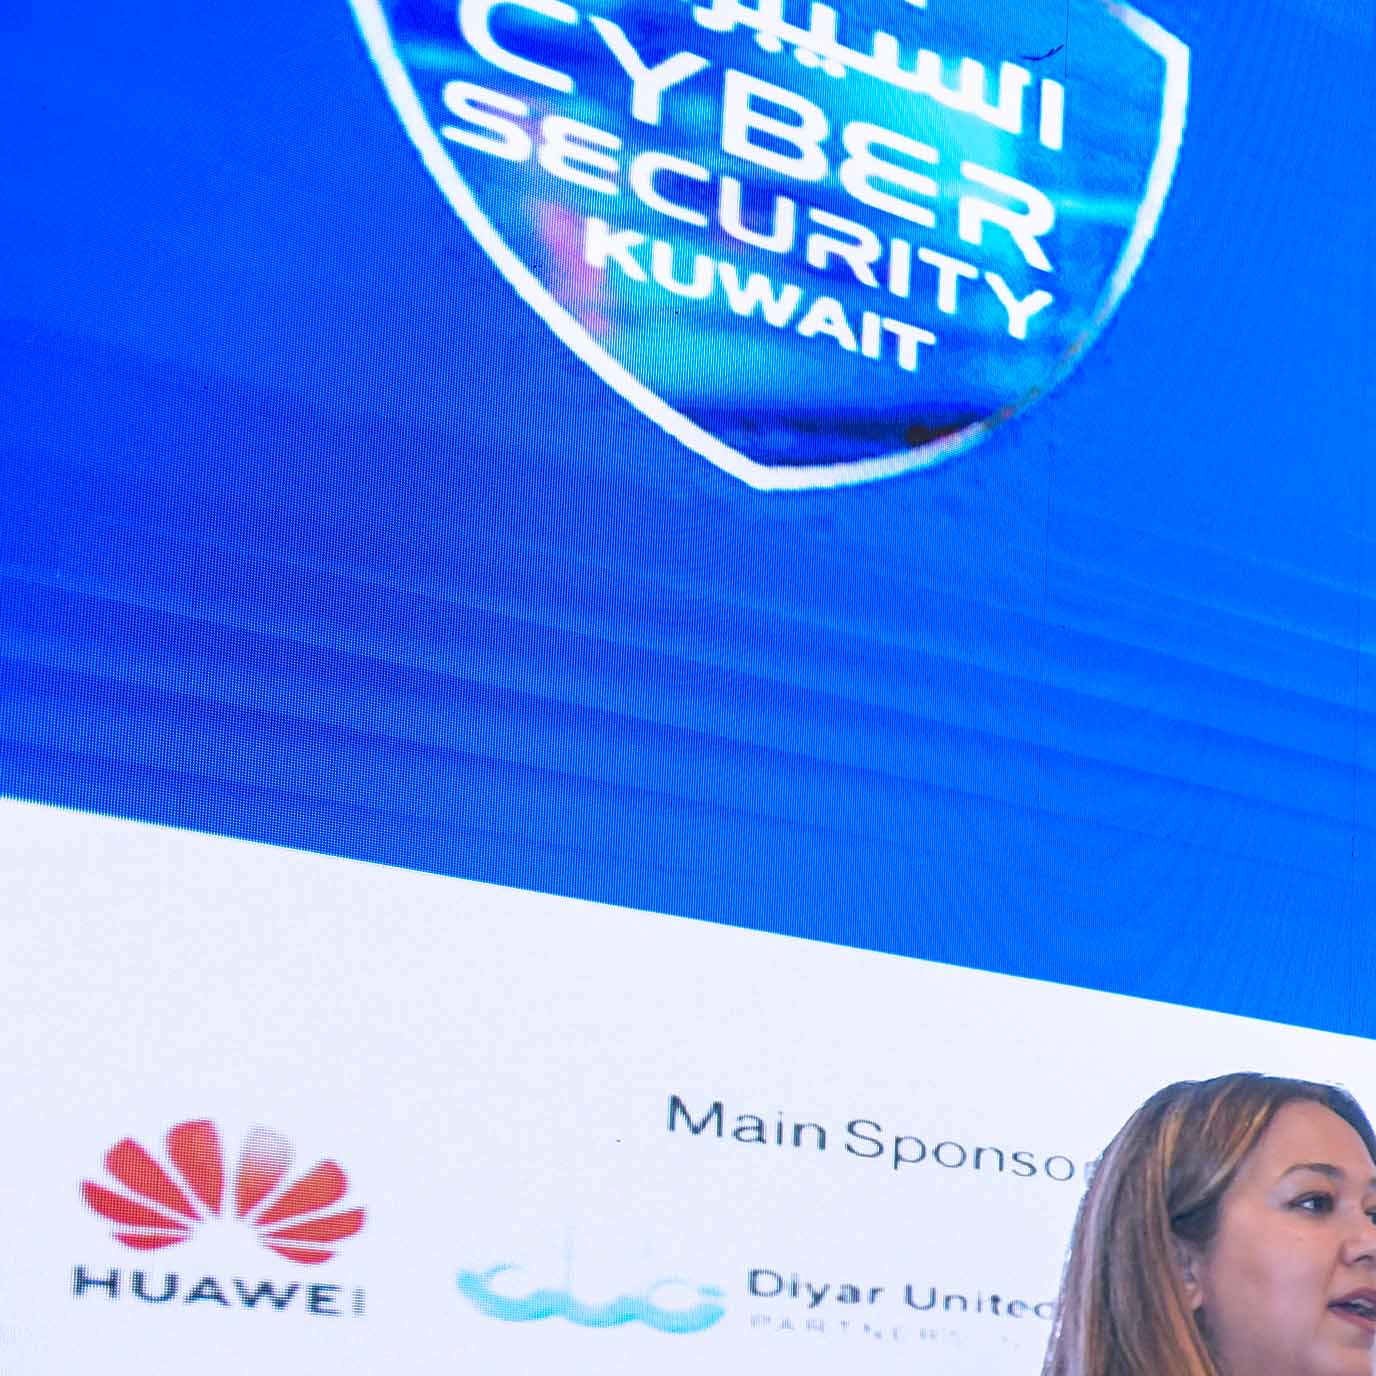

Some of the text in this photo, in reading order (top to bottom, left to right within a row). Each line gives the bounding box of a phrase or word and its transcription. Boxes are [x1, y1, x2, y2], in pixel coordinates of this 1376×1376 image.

[459, 0, 1057, 274] CYBER
[442, 80, 1053, 341] SECURITY
[584, 215, 936, 372] KUWAIT
[666, 1093, 827, 1152] Main
[70, 1264, 368, 1318] HUAWEI
[748, 1268, 885, 1309] Diyar
